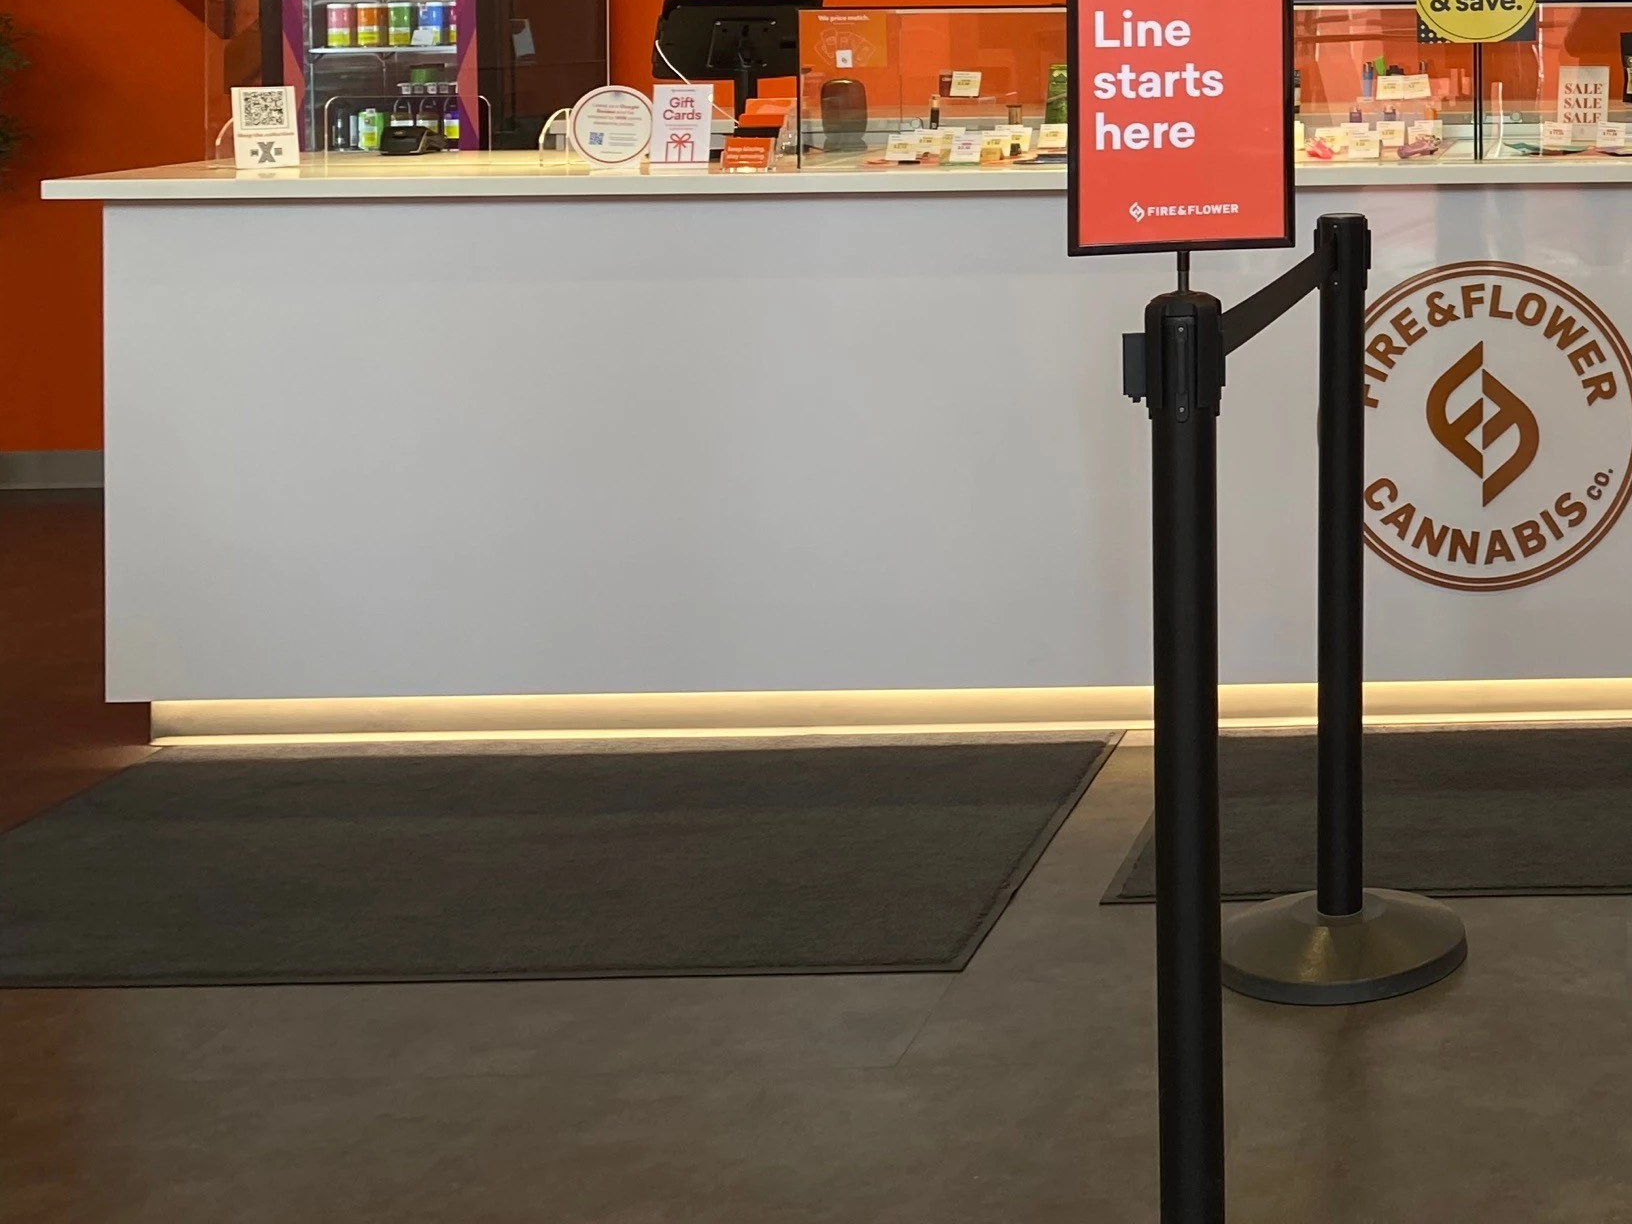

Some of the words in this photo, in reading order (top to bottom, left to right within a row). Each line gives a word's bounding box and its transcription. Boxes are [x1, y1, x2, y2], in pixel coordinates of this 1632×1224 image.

[830, 15, 847, 23] price
[1094, 9, 1191, 48] Line
[1093, 62, 1224, 100] starts
[1564, 83, 1603, 95] SALE
[669, 97, 695, 108] Gift
[1563, 98, 1602, 109] SALE
[662, 109, 702, 120] Cards
[1563, 113, 1602, 124] SALE
[1095, 112, 1195, 150] here
[1147, 203, 1239, 217] FIRE&FLOWER
[1364, 477, 1588, 565] CANNABIS
[1587, 468, 1614, 501] CO.
